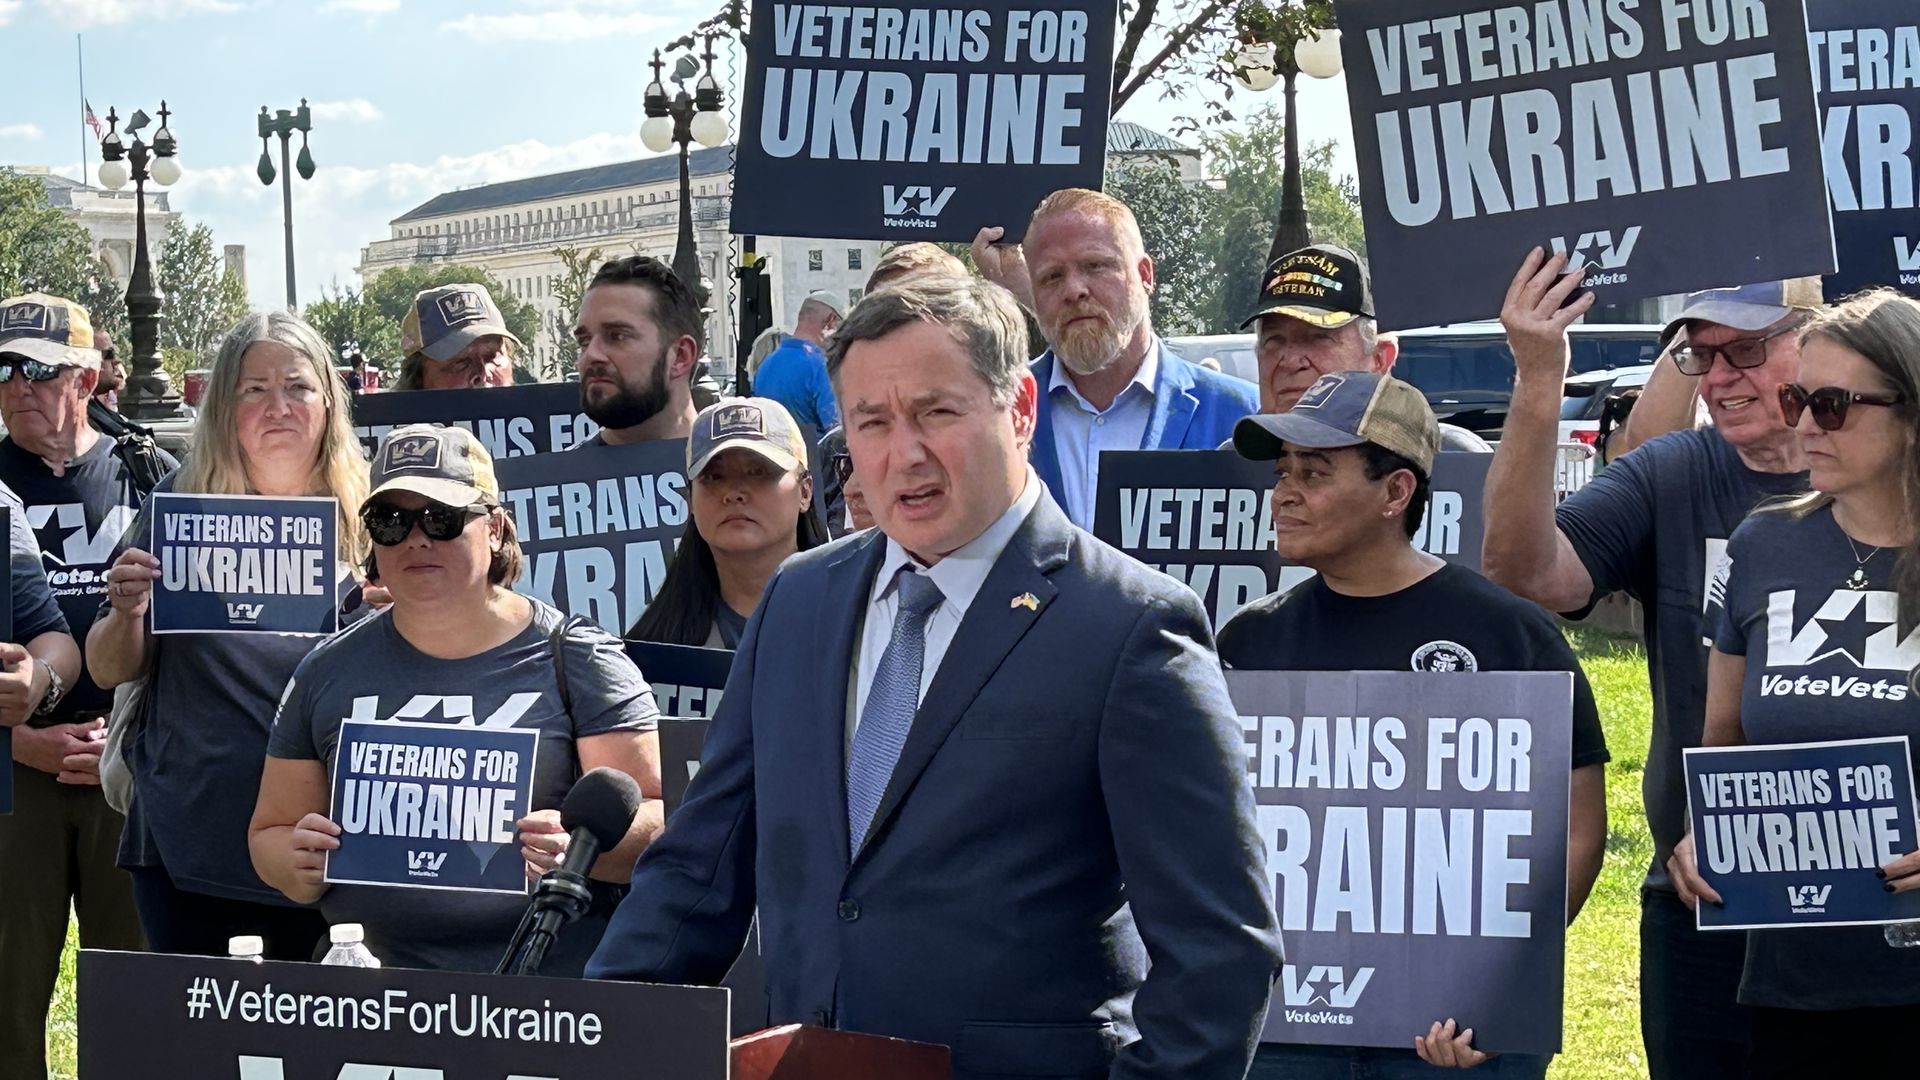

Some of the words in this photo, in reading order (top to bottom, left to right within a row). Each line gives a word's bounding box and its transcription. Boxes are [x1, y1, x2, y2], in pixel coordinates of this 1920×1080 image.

[772, 3, 991, 62] VETERANS
[1004, 10, 1089, 64] FOR
[1366, 0, 1644, 96] VETERANS
[1662, 0, 1769, 53] FOR
[1808, 26, 1920, 92] TERA
[759, 67, 1086, 165] UKRAINE
[1374, 52, 1790, 228] UKRAINE
[549, 413, 600, 453] FO
[164, 513, 274, 543] VETERANS
[281, 516, 323, 545] FOR
[500, 471, 688, 542] TERANS
[1119, 488, 1279, 551] VETERA
[162, 546, 324, 595] UKRAINE
[1761, 674, 1909, 701] VoteVets
[350, 741, 467, 780] VETERANS
[472, 749, 519, 783] FOR
[1237, 716, 1407, 790] RANS
[1426, 717, 1532, 792] FOR
[1699, 768, 1832, 808] VETERANS
[1838, 764, 1894, 802] FOR
[341, 779, 517, 844] UKRAINE
[1703, 806, 1904, 875] UKRAINE
[1256, 804, 1533, 938] RAINE
[187, 976, 602, 1046] #VeteransForUkraine
